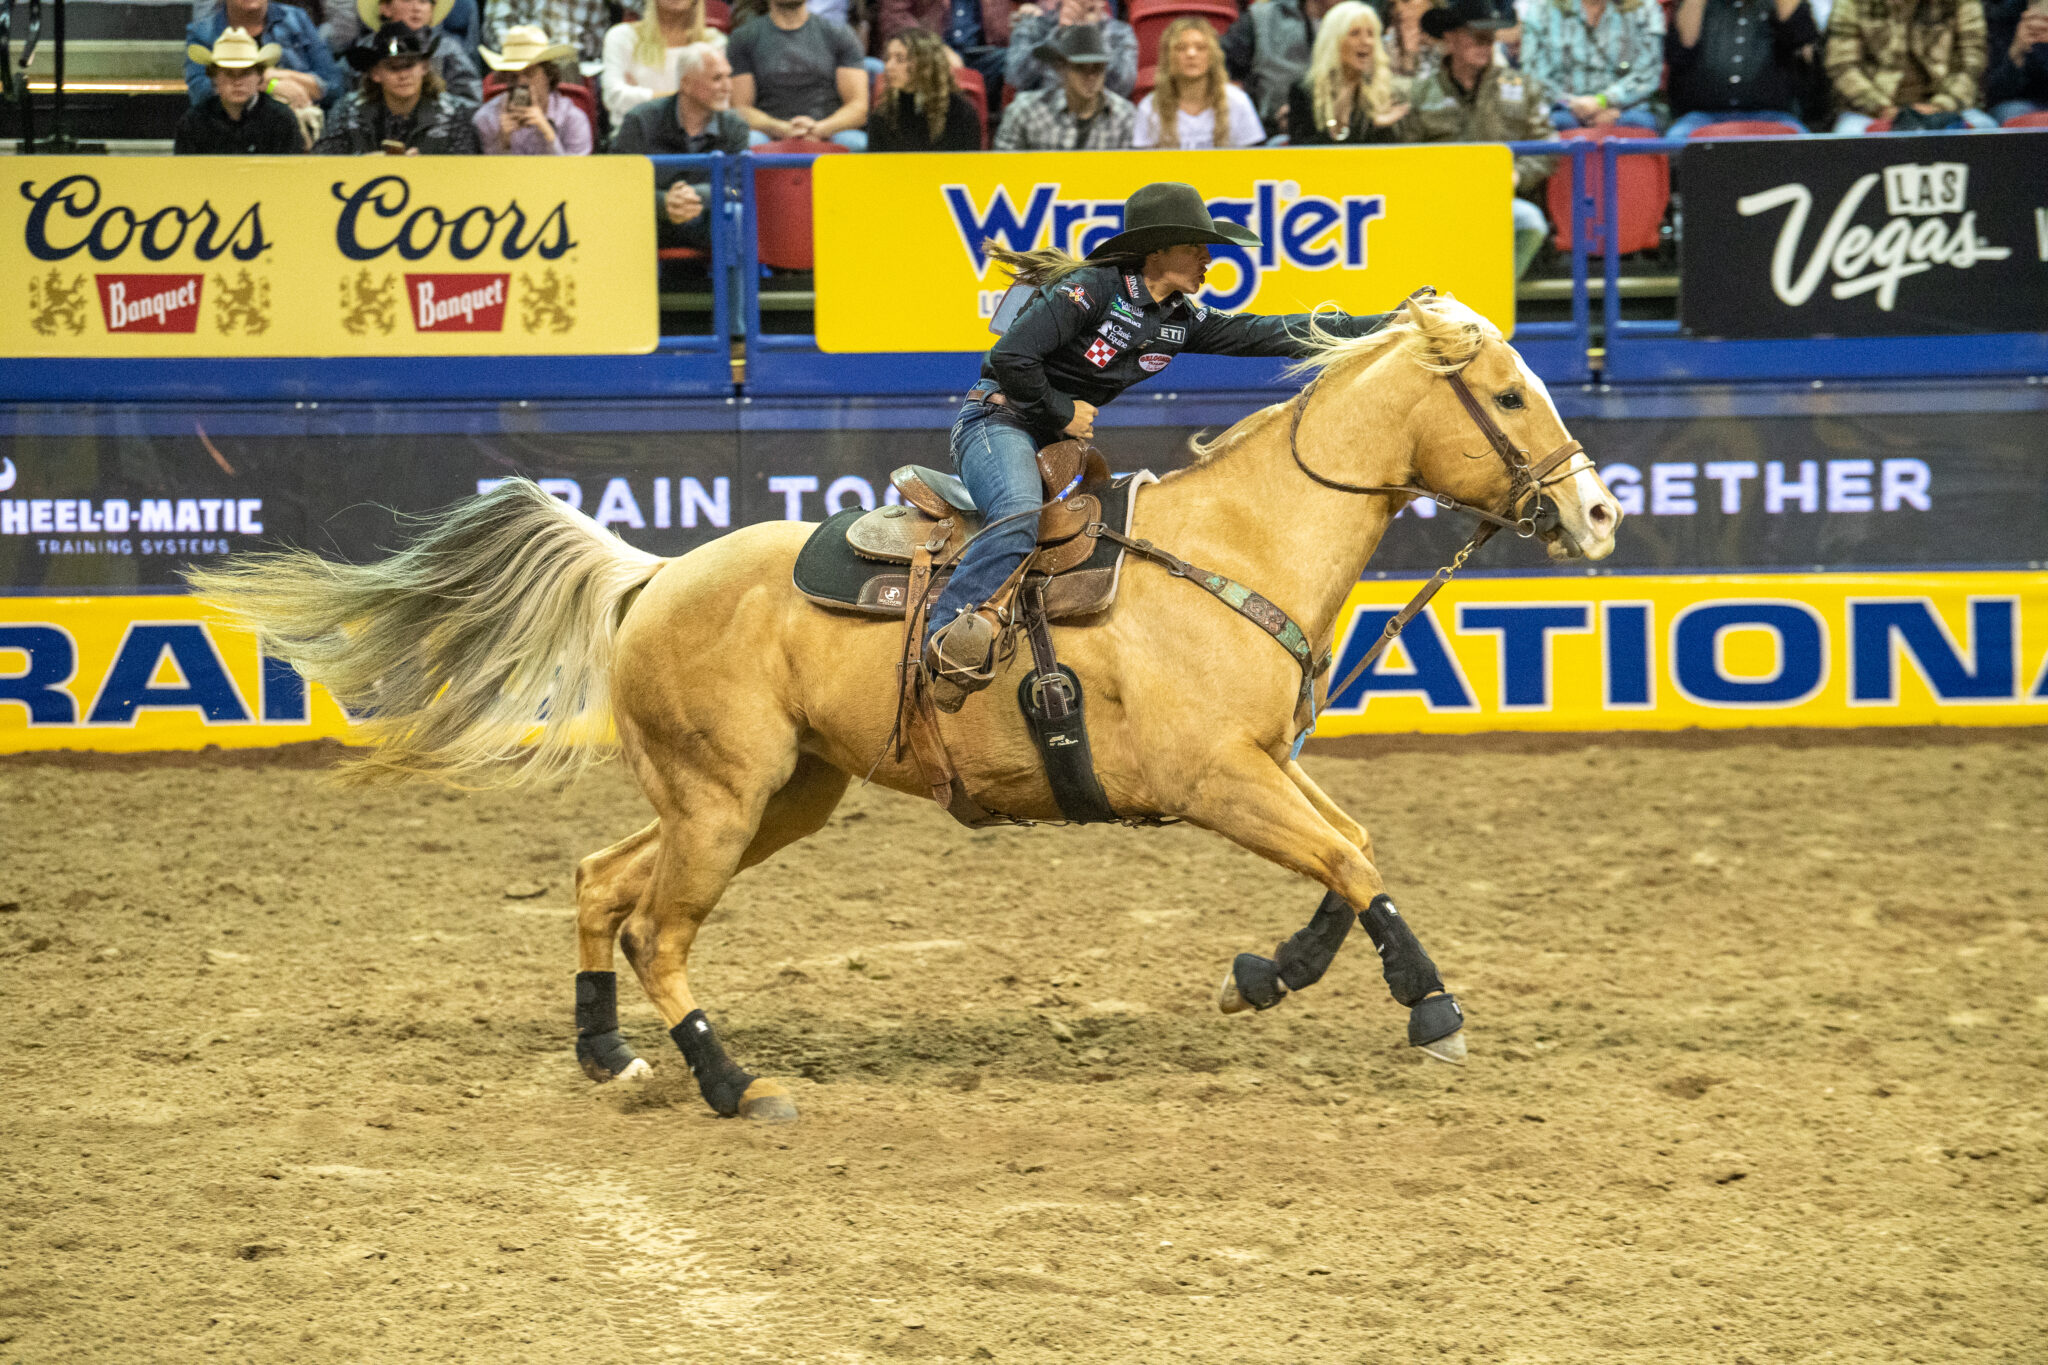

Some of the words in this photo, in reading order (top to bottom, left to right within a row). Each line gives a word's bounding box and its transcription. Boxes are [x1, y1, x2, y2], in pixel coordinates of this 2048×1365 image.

[1895, 170, 1957, 207] LAS
[20, 174, 272, 261] Coors
[331, 175, 578, 261] Coors
[1737, 173, 2011, 311] Vegas
[943, 182, 1383, 311] Wragler
[108, 279, 197, 329] Banquet
[417, 277, 504, 329] Banquet
[1107, 332, 1128, 349] Equine
[1599, 459, 1932, 515] GETHER
[37, 539, 133, 555] TRAINING
[141, 539, 230, 555] SYSTEMS
[1316, 596, 2048, 713] ATION
